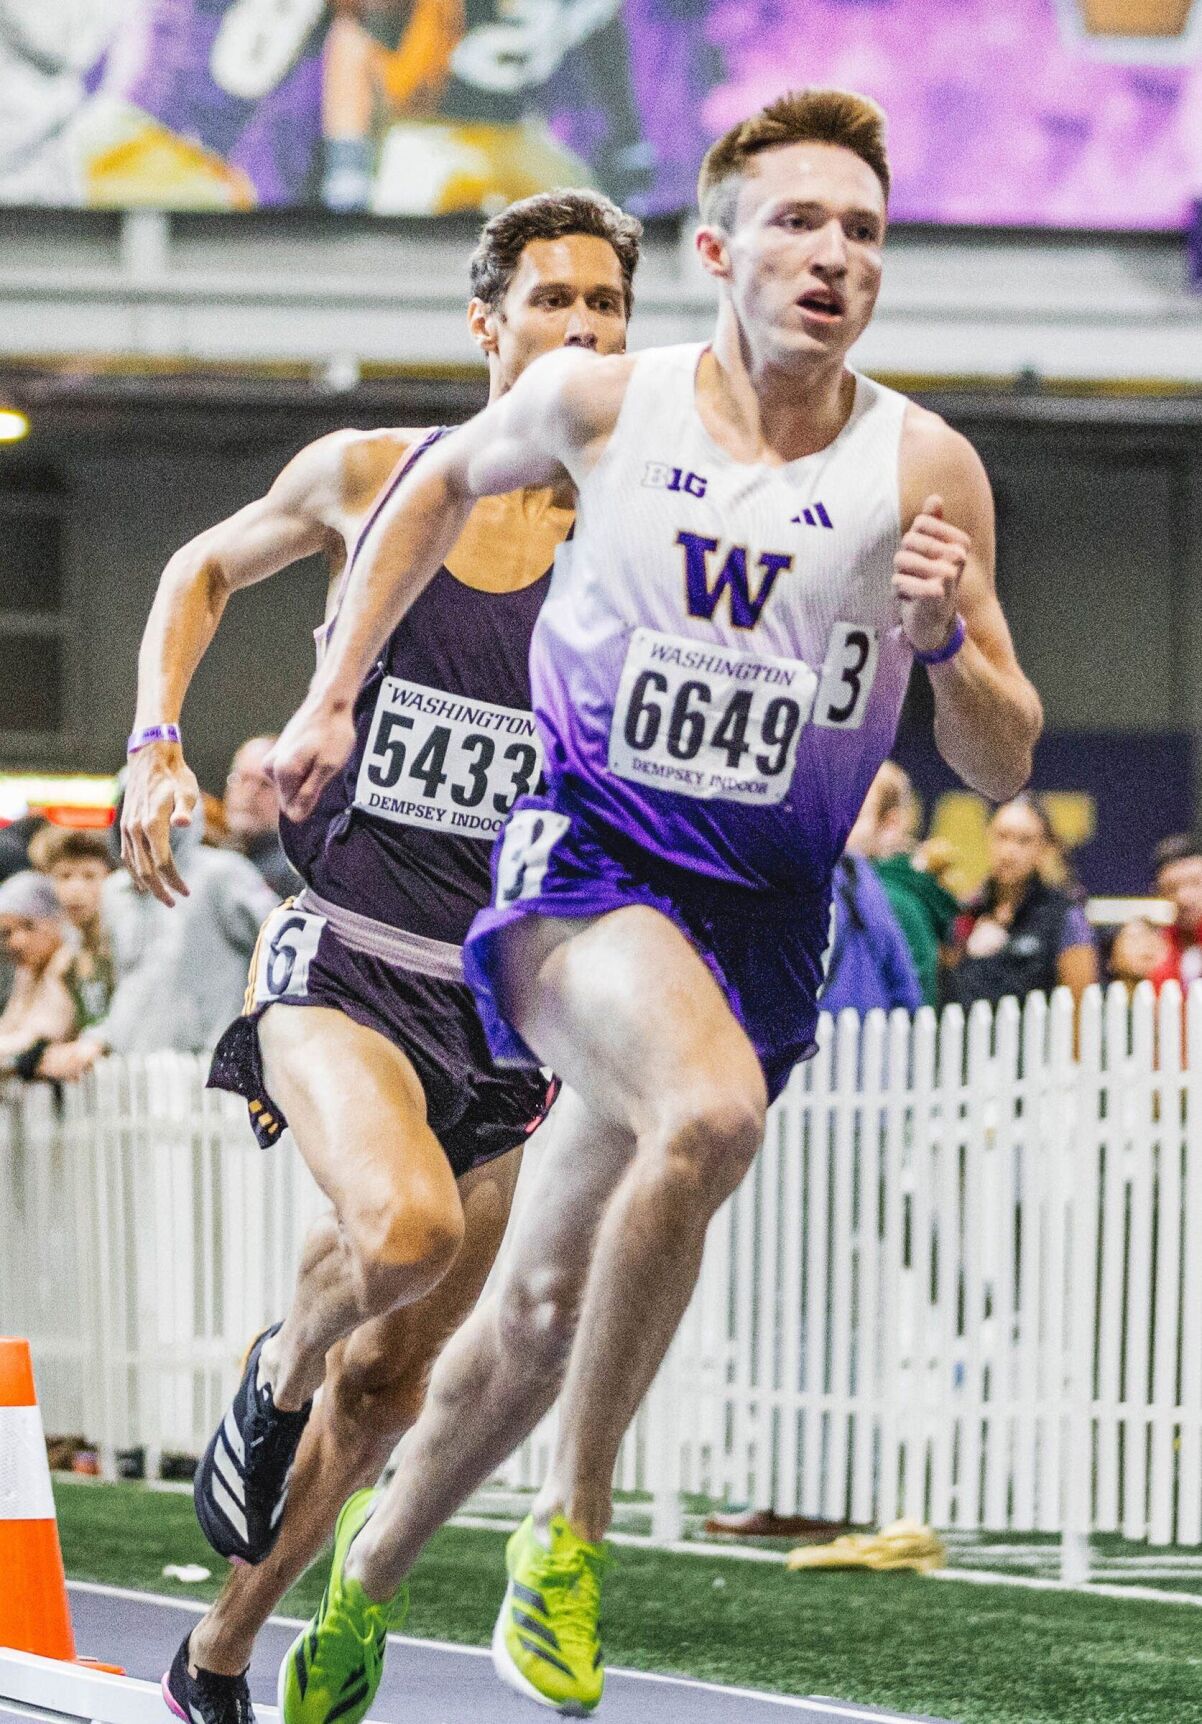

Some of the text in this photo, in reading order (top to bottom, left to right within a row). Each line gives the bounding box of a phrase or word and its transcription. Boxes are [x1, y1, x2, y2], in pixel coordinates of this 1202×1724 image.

[675, 530, 794, 631] W
[650, 642, 798, 686] WASHINGTON
[826, 631, 870, 722] 3
[391, 686, 536, 738] WASHINGTON
[623, 670, 800, 776] 6649
[367, 710, 537, 815] 5433
[632, 757, 769, 795] DEMPSEY INDOOR
[368, 793, 503, 832] DEMPSEY INDOO
[266, 917, 307, 995] 6
